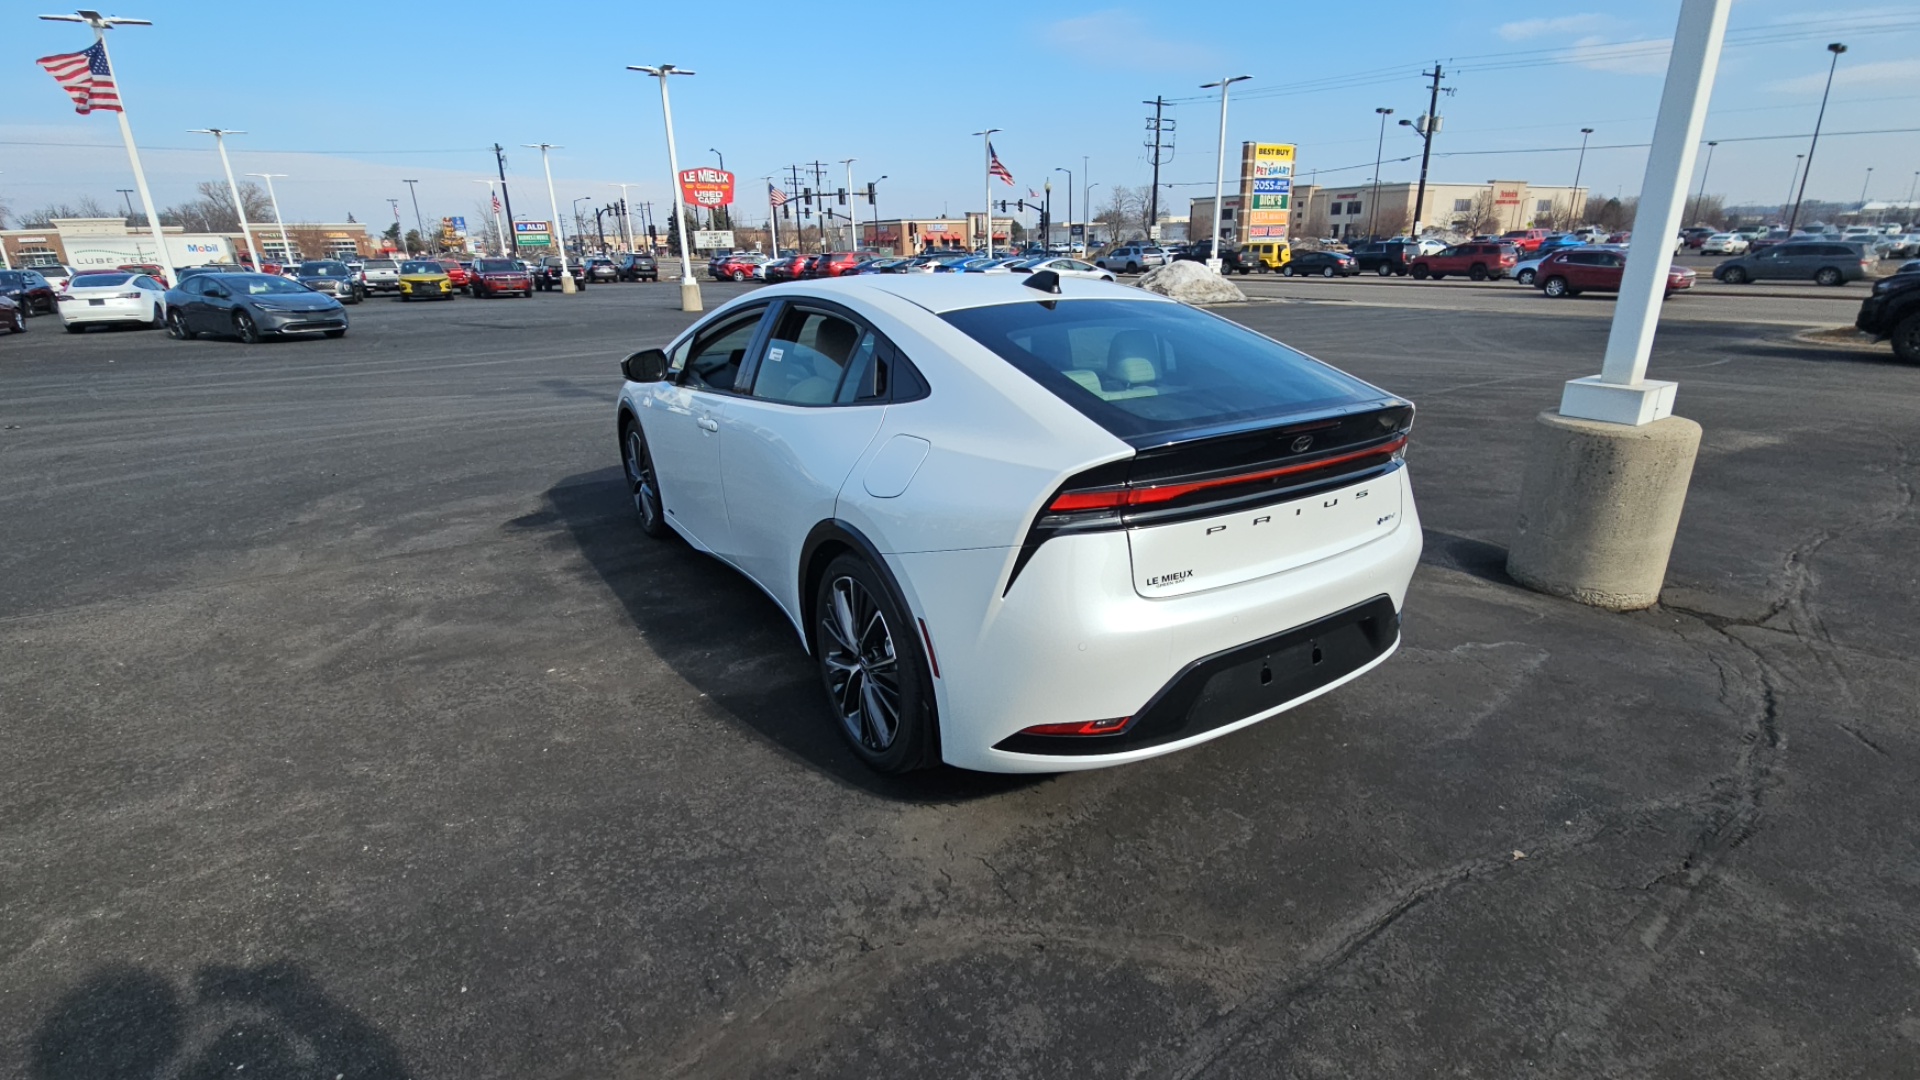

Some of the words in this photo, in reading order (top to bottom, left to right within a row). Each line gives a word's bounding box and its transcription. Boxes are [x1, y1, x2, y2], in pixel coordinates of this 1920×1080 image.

[683, 171, 696, 182] LE
[698, 169, 729, 183] MIEUX
[694, 190, 723, 198] USED
[1259, 195, 1282, 206] DICK'S
[526, 223, 546, 231] ALDI
[187, 244, 218, 252] Mobil
[1206, 489, 1369, 535] PRIUS
[1146, 576, 1159, 586] LE
[1161, 569, 1193, 583] MIEUX
